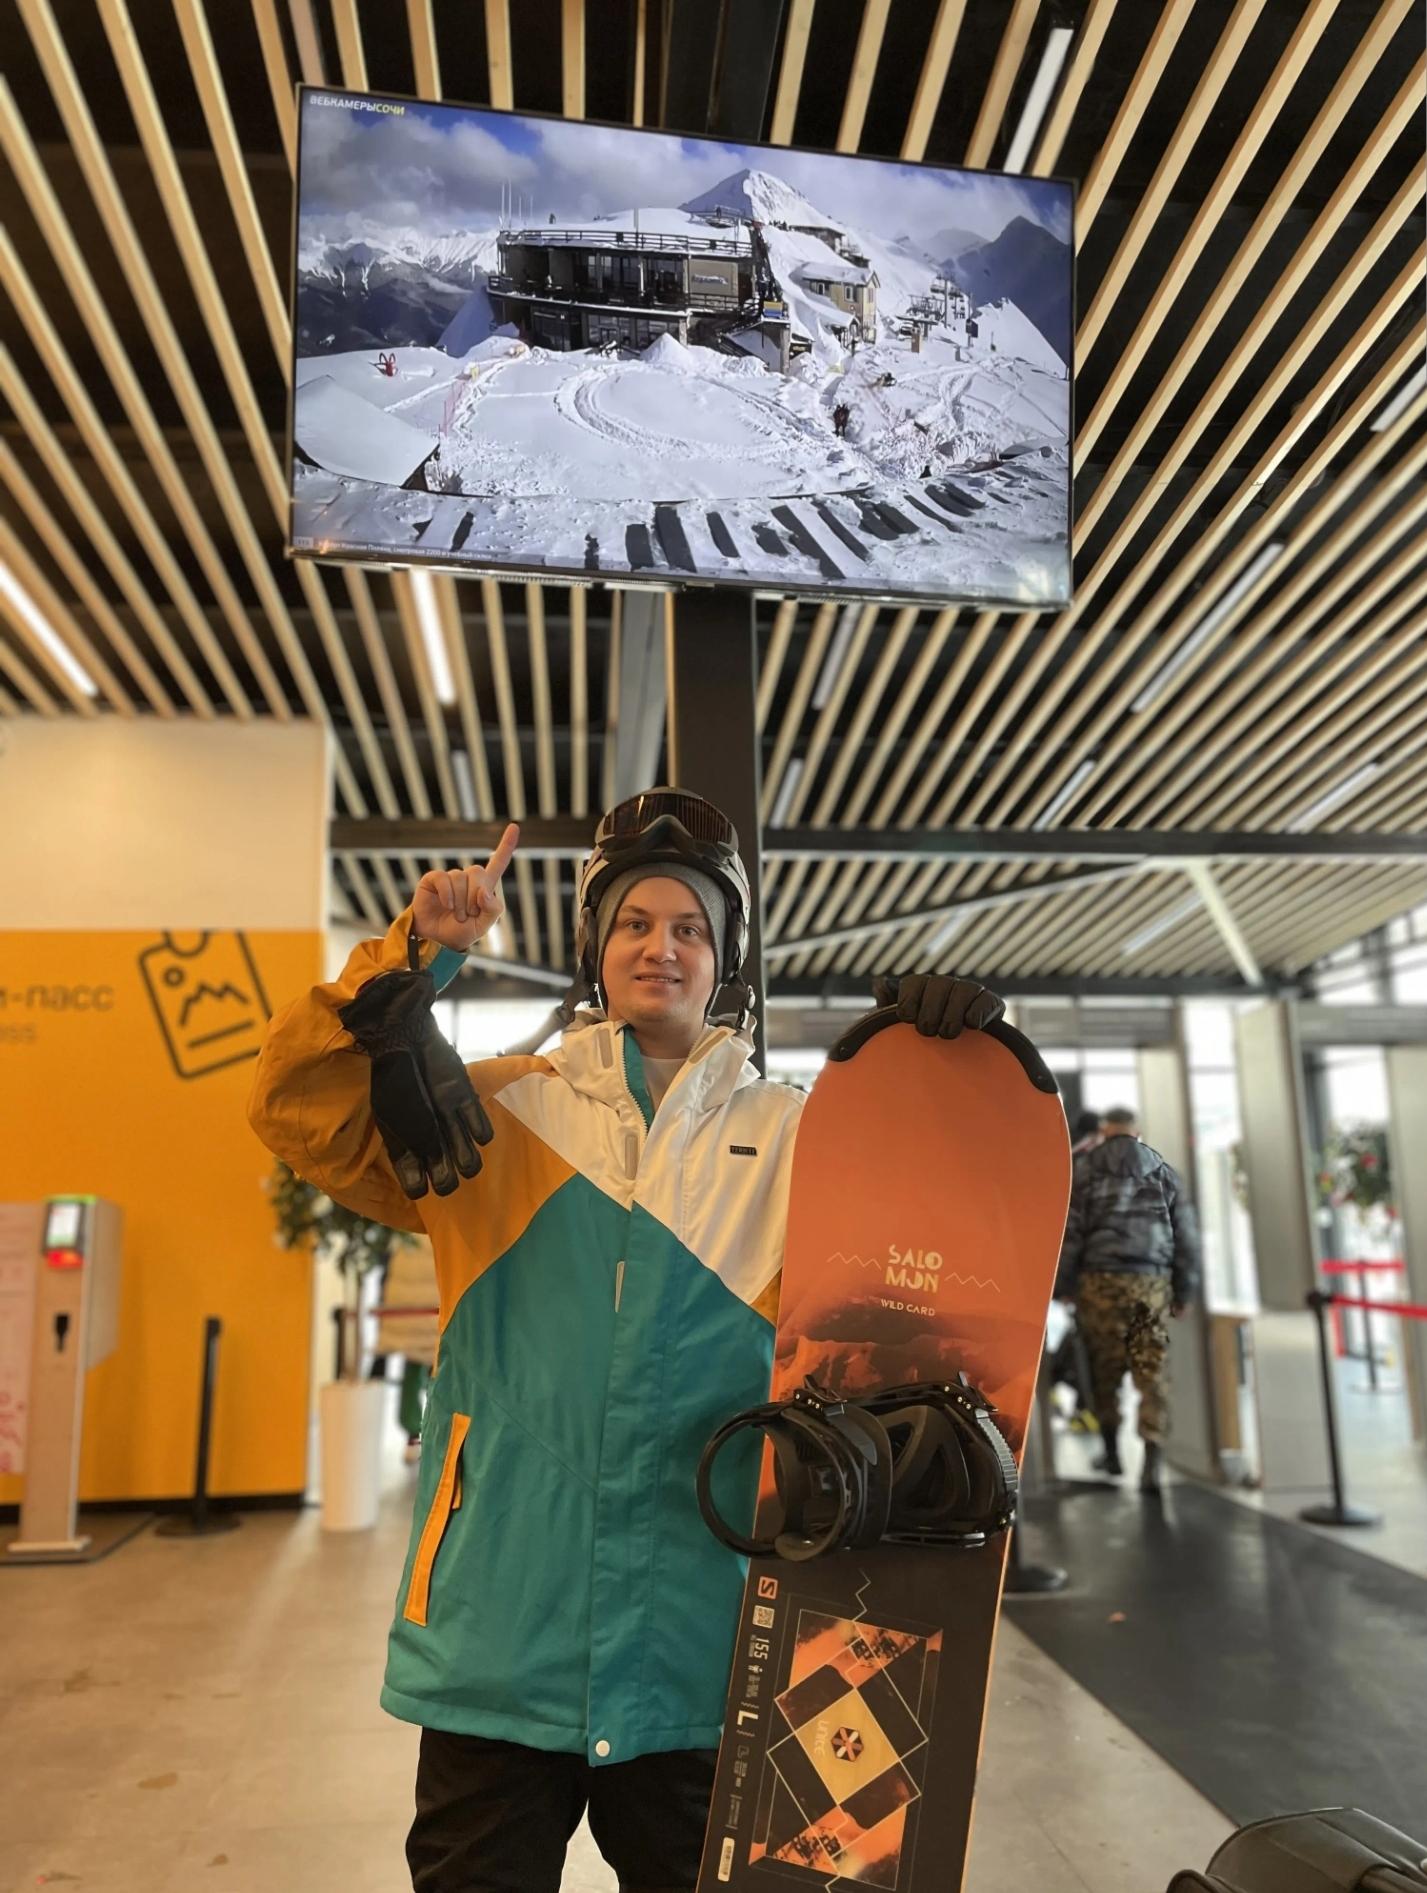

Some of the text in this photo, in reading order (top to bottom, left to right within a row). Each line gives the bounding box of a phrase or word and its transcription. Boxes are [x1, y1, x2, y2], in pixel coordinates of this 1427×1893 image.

[0, 985, 115, 1012] -пасс
[888, 1244, 943, 1270] SALO
[880, 1298, 936, 1317] WILD CARD
[753, 1638, 770, 1660] 155
[737, 1710, 759, 1725] L
